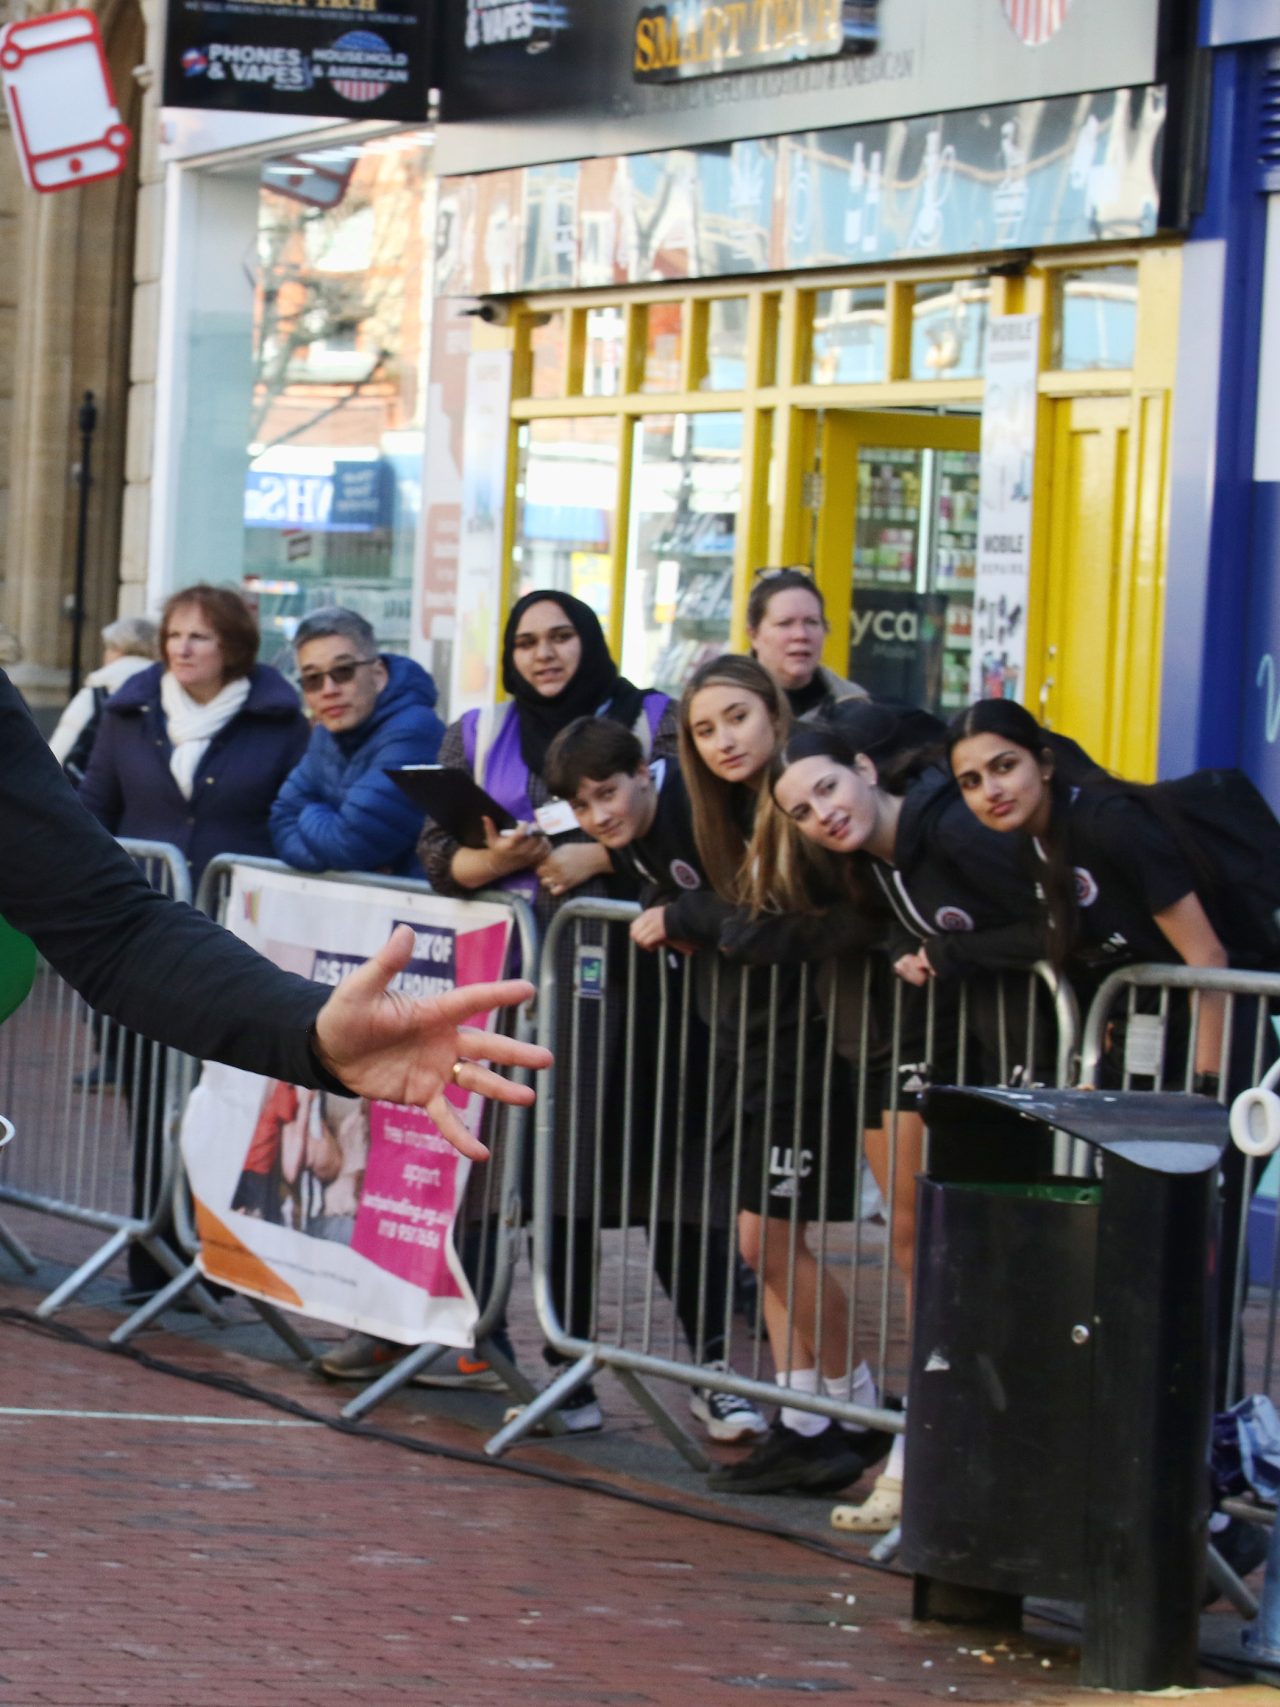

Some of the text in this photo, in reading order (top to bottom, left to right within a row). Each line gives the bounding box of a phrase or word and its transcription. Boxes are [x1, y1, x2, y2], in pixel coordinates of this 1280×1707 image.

[208, 43, 301, 66] PHONES
[312, 49, 408, 67] HOUSEHOLD
[207, 62, 305, 84] & VAPES
[312, 65, 409, 83] & AMERICAN
[983, 533, 1023, 554] MOBILE
[431, 935, 453, 963] OF
